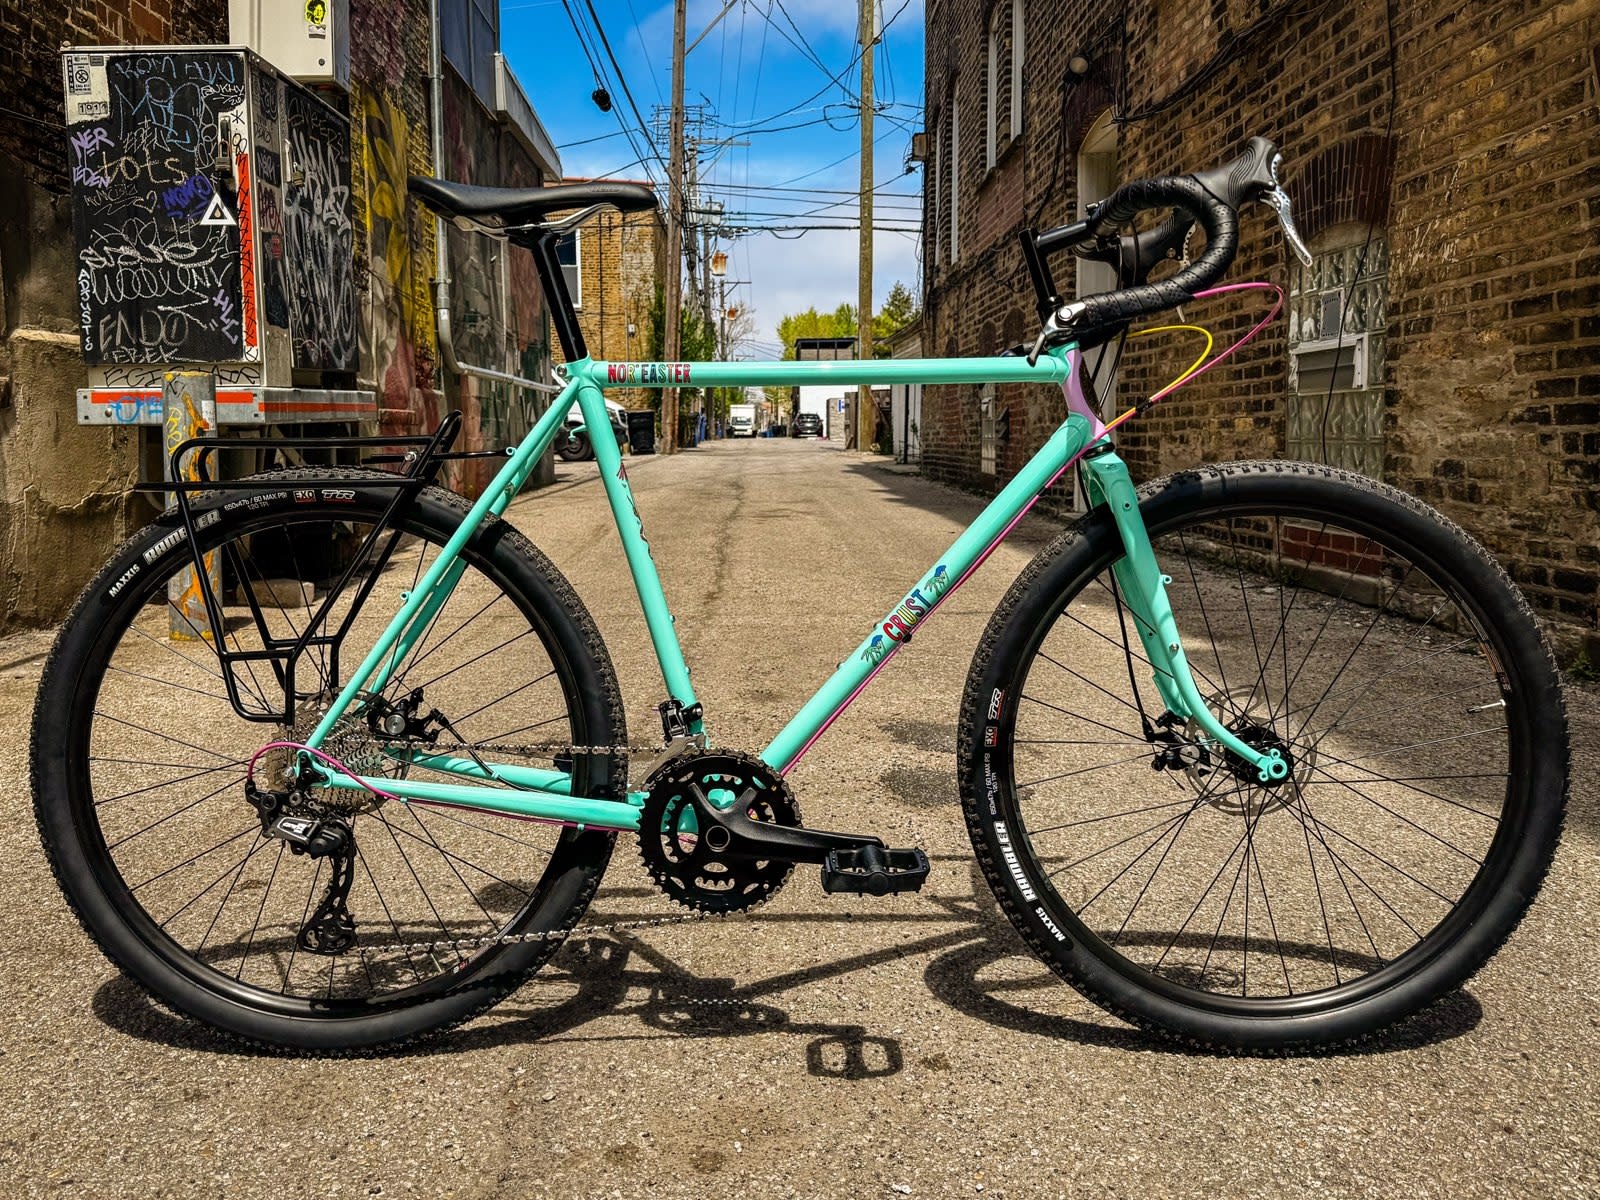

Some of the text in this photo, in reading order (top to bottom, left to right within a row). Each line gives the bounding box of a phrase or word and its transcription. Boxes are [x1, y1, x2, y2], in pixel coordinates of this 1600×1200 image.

[294, 490, 315, 500] EXO
[142, 509, 220, 565] RAMBER
[109, 564, 140, 597] MAXXIS
[883, 589, 932, 641] CRUST
[985, 727, 995, 746] EXO
[1035, 906, 1066, 942] MAXXIS
